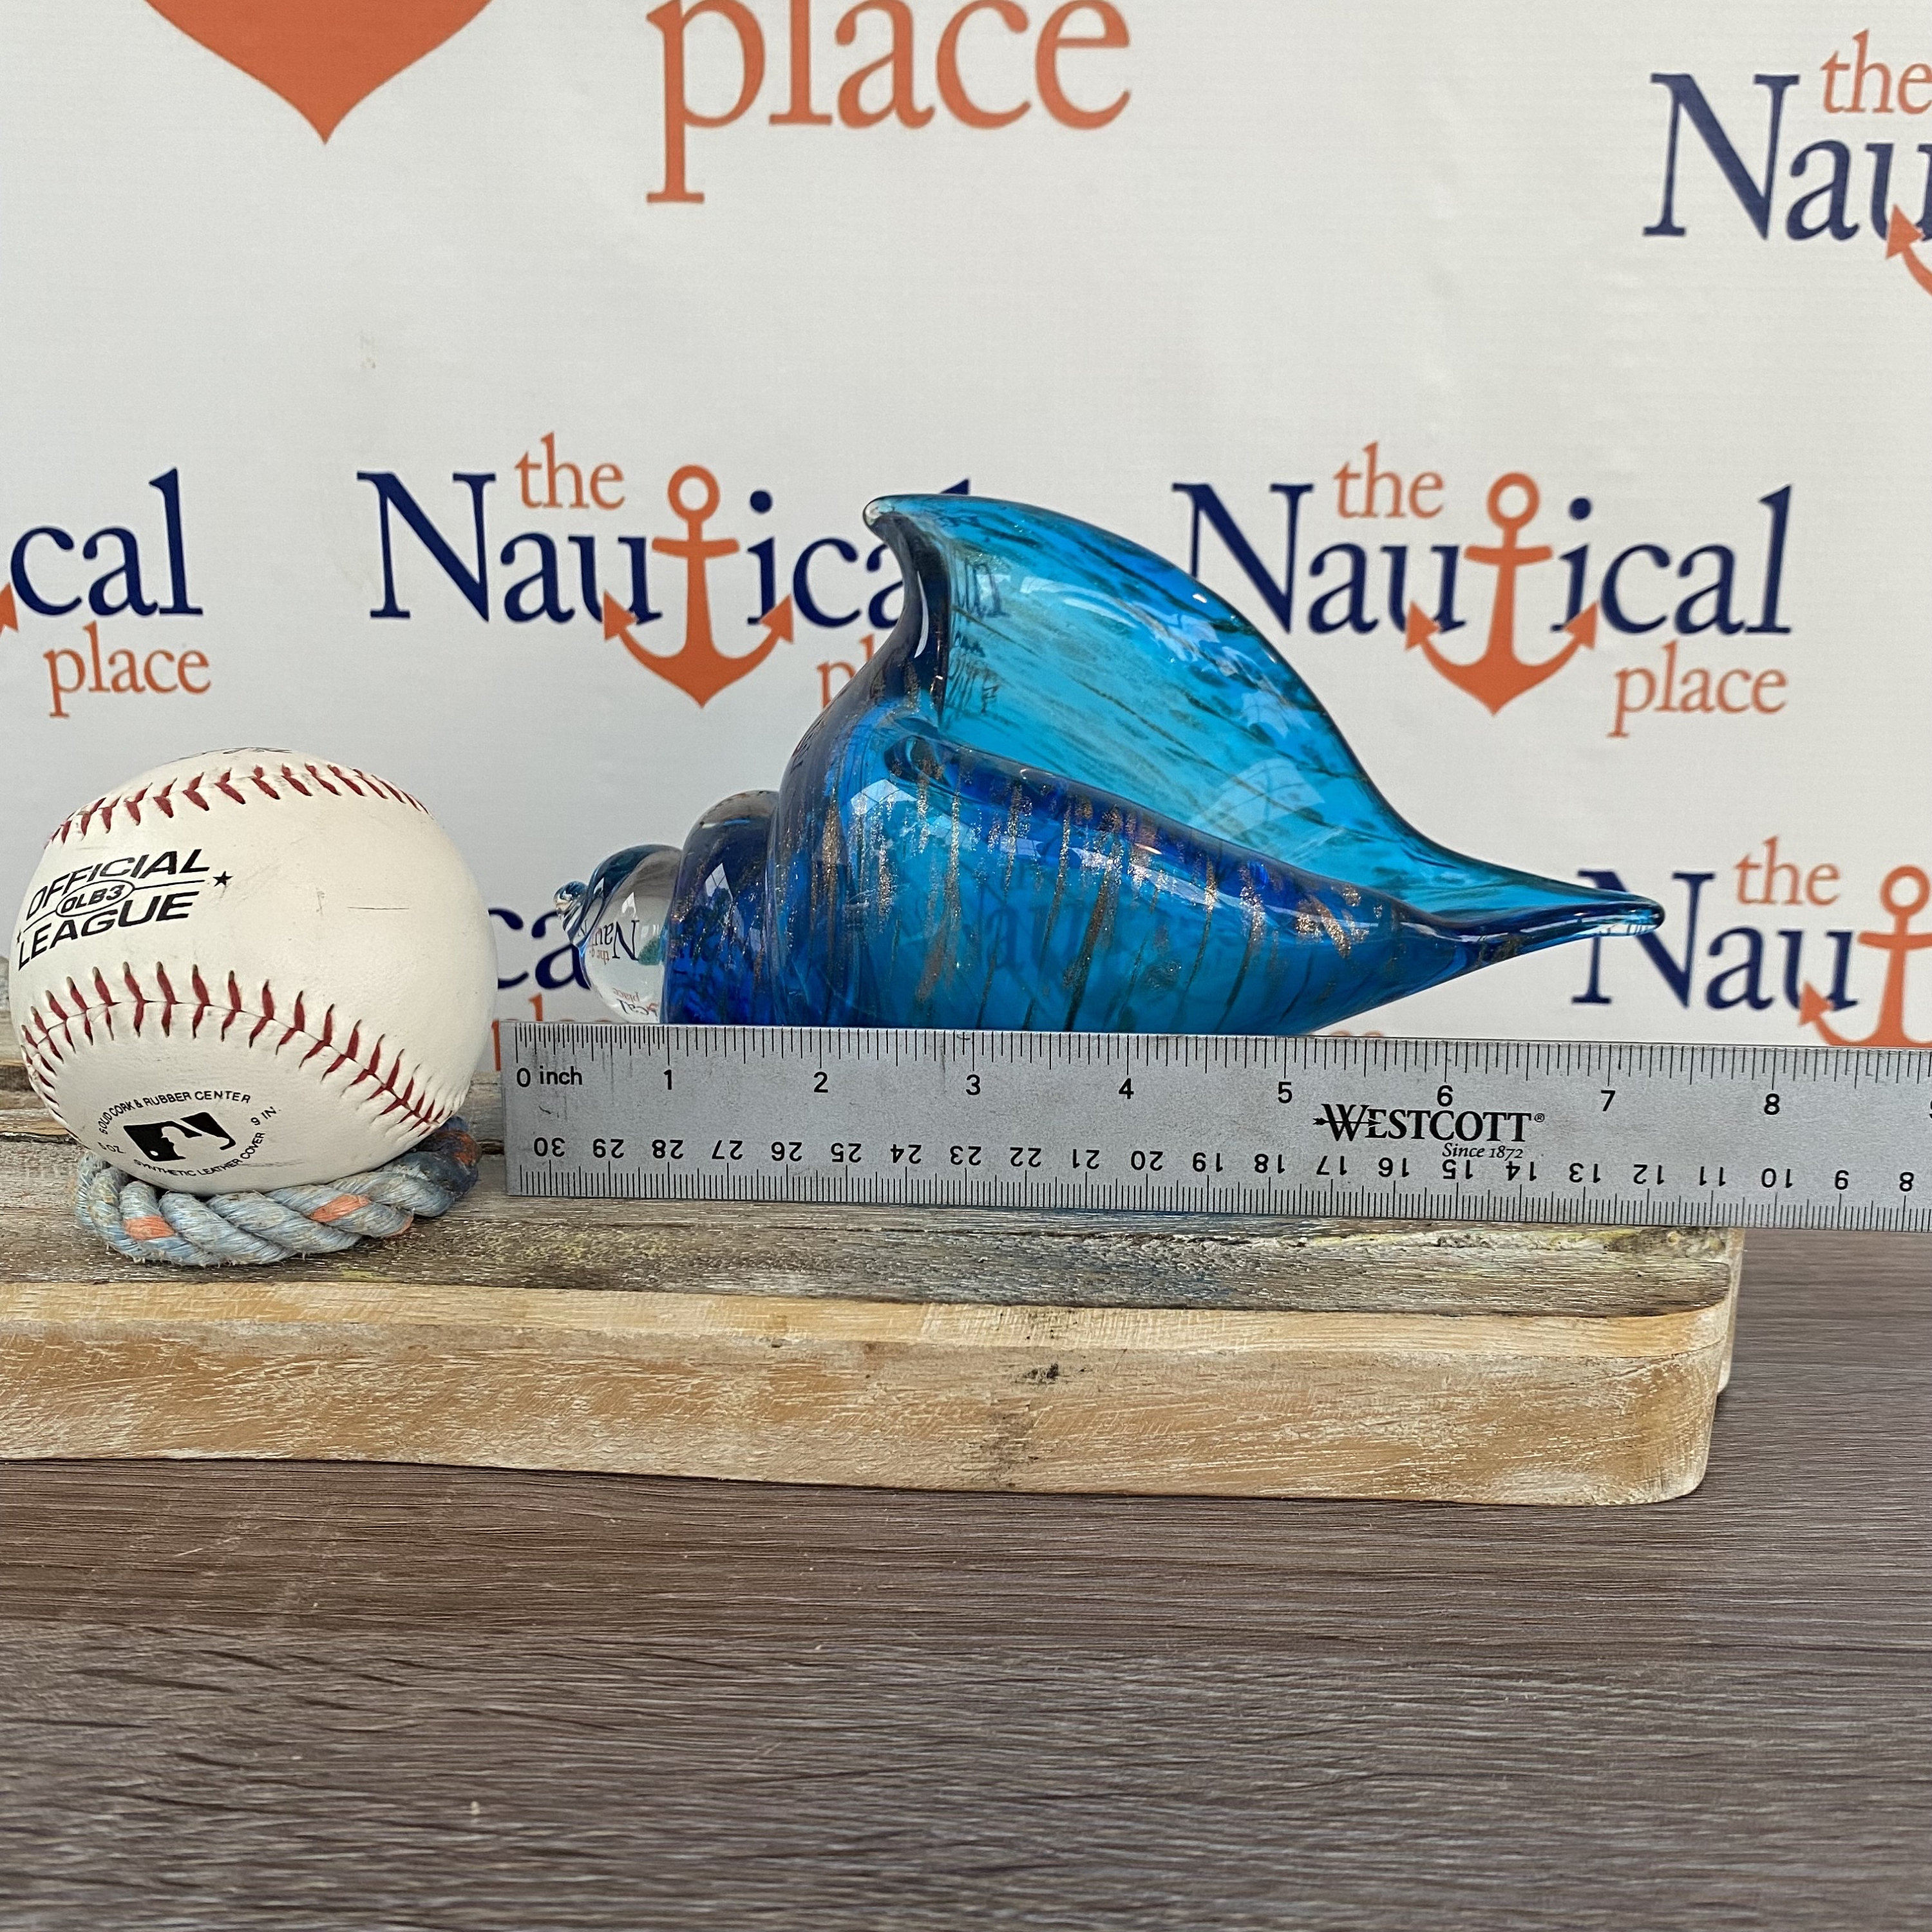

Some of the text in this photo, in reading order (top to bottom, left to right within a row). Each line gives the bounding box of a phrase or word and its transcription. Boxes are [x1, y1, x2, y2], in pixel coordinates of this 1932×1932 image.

[1819, 28, 1932, 115] the
[645, 0, 1132, 205] place
[515, 431, 626, 510] the
[1333, 440, 1444, 519] the
[10, 466, 204, 616] cal
[43, 620, 211, 719] place
[1605, 639, 1788, 738] place
[1734, 835, 1842, 906] the
[26, 849, 211, 920] OFFICIAL
[18, 891, 200, 971] LEAGUE
[516, 1065, 583, 1088] 0 inch
[663, 1069, 672, 1090] 1
[813, 1071, 829, 1094] 2
[965, 1074, 981, 1096] 3
[1118, 1077, 1134, 1100] 4
[1278, 1081, 1293, 1104] 5
[1437, 1084, 1454, 1107] 6
[1600, 1090, 1616, 1112] 7
[1763, 1093, 1780, 1115] 8
[98, 1090, 251, 1135] SOLID CORK & RUBBER CENTER
[251, 1117, 261, 1126] 9
[133, 1132, 266, 1177] SYNTHETIC LEATHER COVER
[533, 1137, 565, 1158] 30
[592, 1138, 625, 1159] 29
[651, 1139, 684, 1160] 28
[711, 1140, 743, 1160] 27
[771, 1141, 802, 1162] 26
[830, 1142, 862, 1163] 25
[890, 1143, 922, 1164] 24
[949, 1145, 981, 1166] 23
[1010, 1146, 1042, 1168] 22
[1442, 1142, 1524, 1161] Since 1872
[1072, 1148, 1100, 1170] 21
[1130, 1150, 1164, 1171] 20
[1192, 1151, 1224, 1173] 19
[1254, 1153, 1285, 1174] 18
[1316, 1155, 1348, 1176] 17
[1378, 1157, 1410, 1178] 16
[1442, 1159, 1473, 1180] 15
[1505, 1160, 1537, 1182] 14
[1569, 1162, 1601, 1184] 13
[1633, 1164, 1665, 1186] 12
[1699, 1166, 1726, 1187] 11
[1761, 1168, 1793, 1189] 10
[1899, 1171, 1914, 1192] 8
